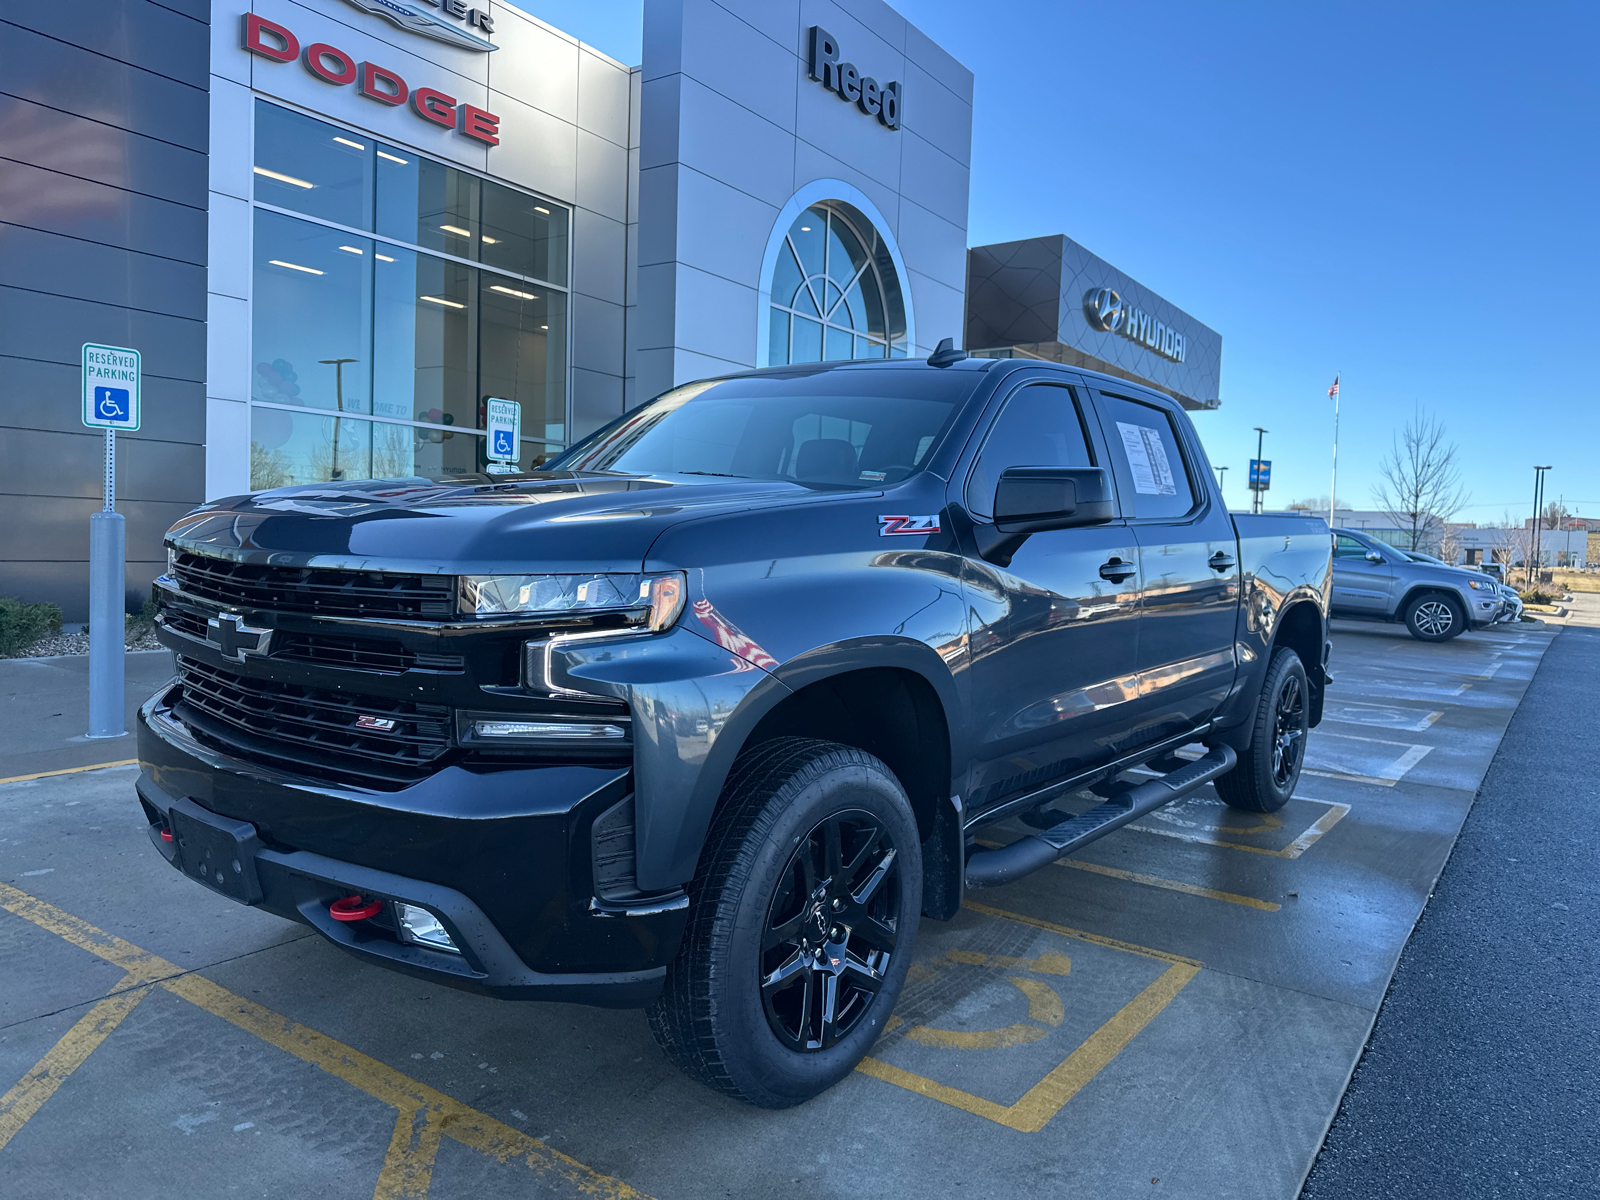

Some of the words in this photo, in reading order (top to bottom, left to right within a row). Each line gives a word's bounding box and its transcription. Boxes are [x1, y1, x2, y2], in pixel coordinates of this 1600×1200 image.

[241, 12, 500, 146] DODGE
[808, 25, 902, 131] Reed
[1126, 304, 1187, 363] HYUNDAI
[88, 352, 135, 368] RESERVED
[88, 366, 135, 382] PARKING
[491, 405, 518, 416] RESERVED
[491, 415, 518, 427] PARKING
[878, 515, 940, 537] Z71
